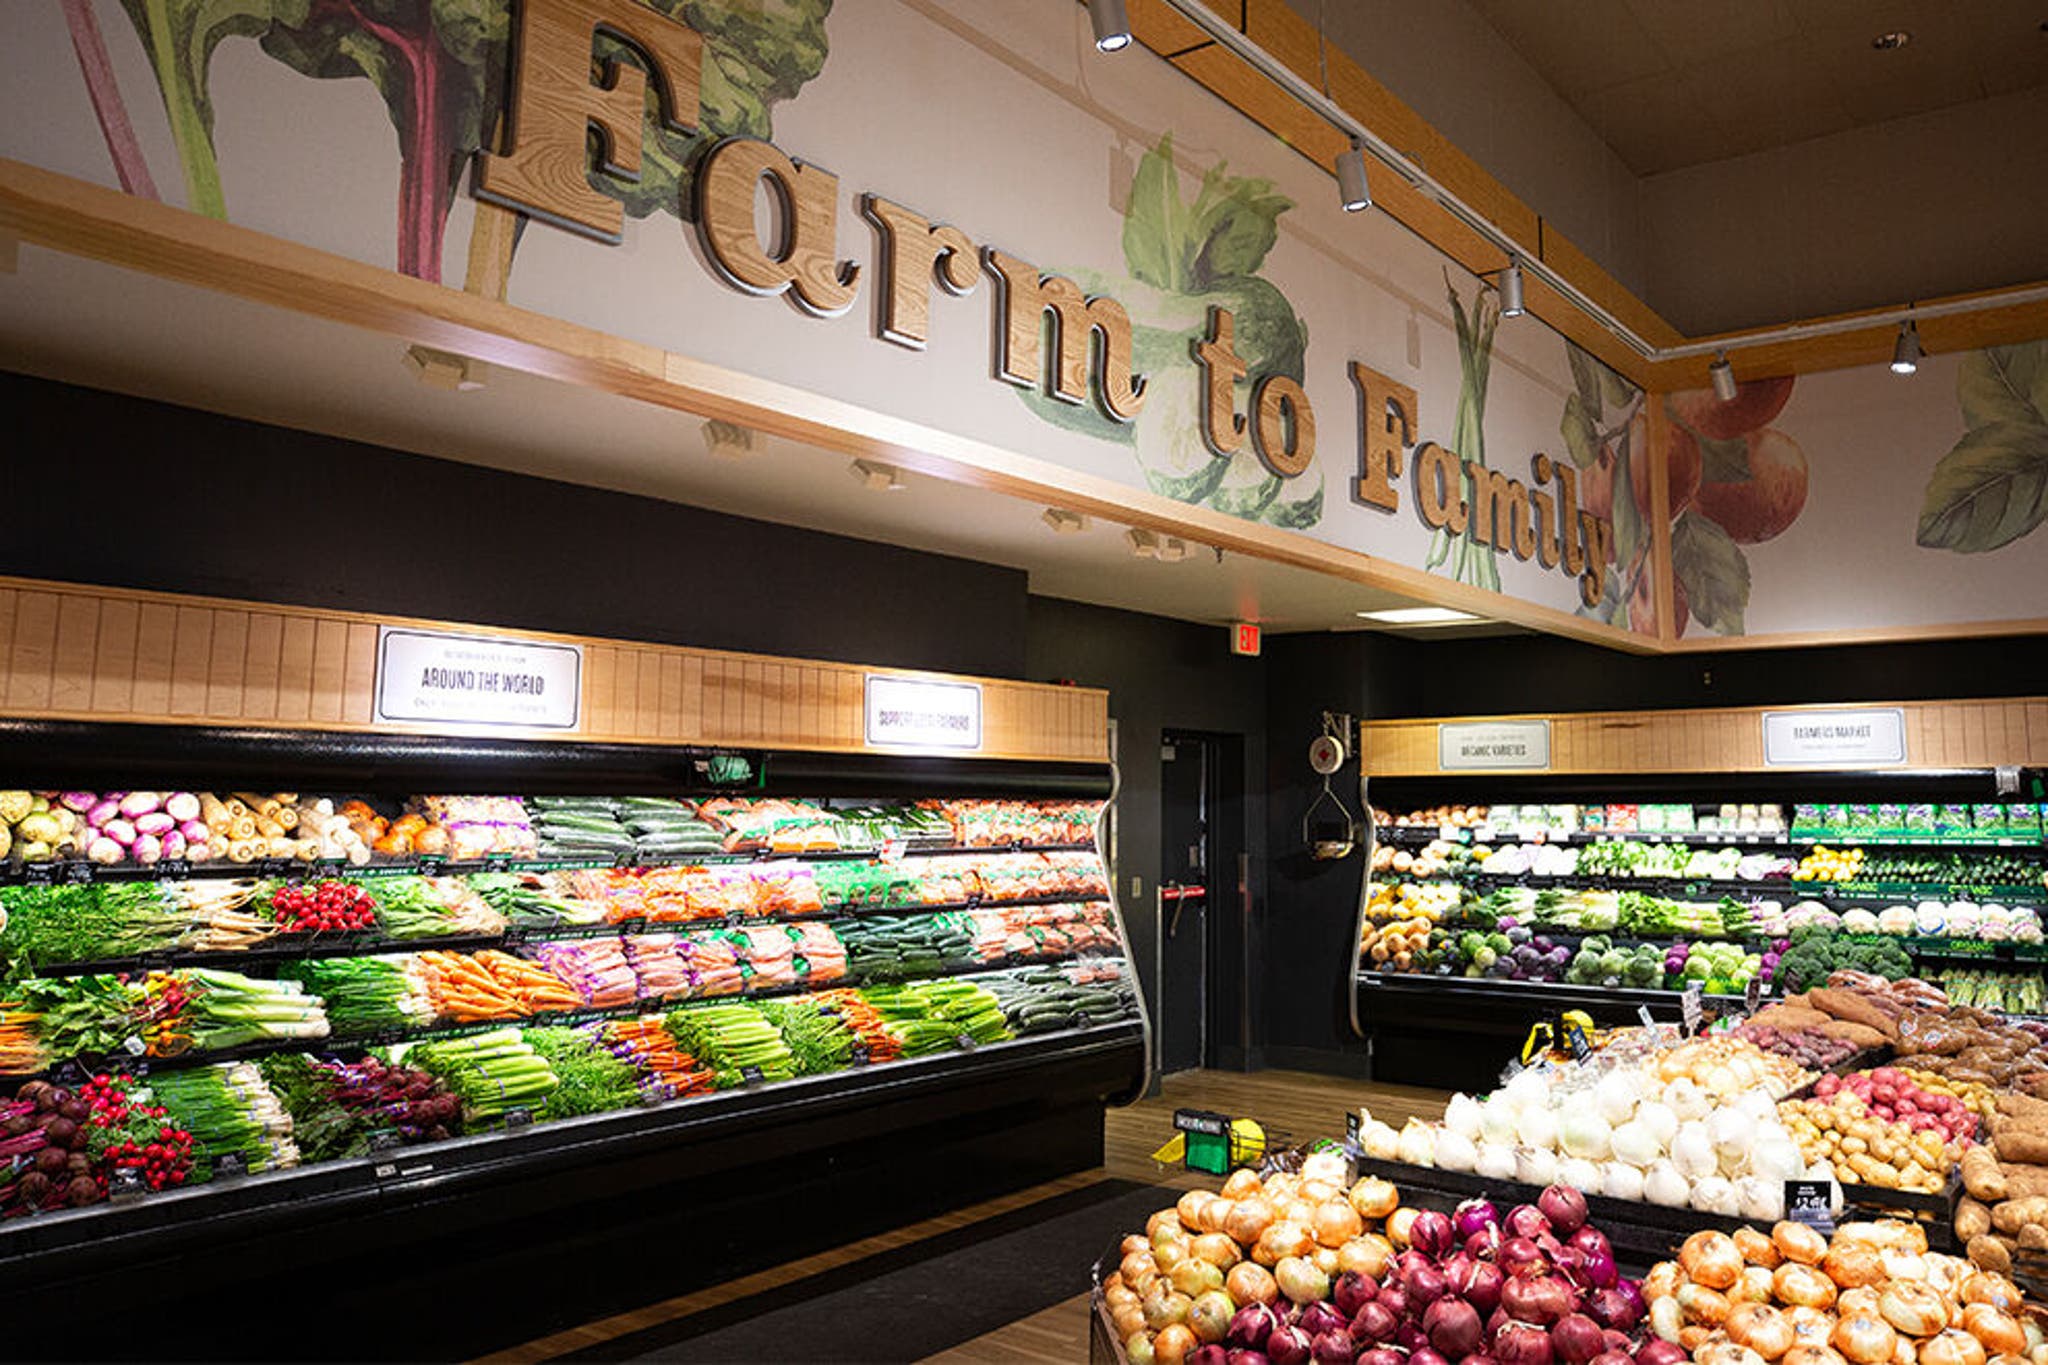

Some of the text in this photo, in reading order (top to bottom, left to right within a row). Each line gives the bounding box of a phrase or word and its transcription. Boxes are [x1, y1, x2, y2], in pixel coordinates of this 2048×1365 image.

[471, 0, 1613, 609] Farm to Family
[421, 666, 545, 695] AROUND THE WORLD
